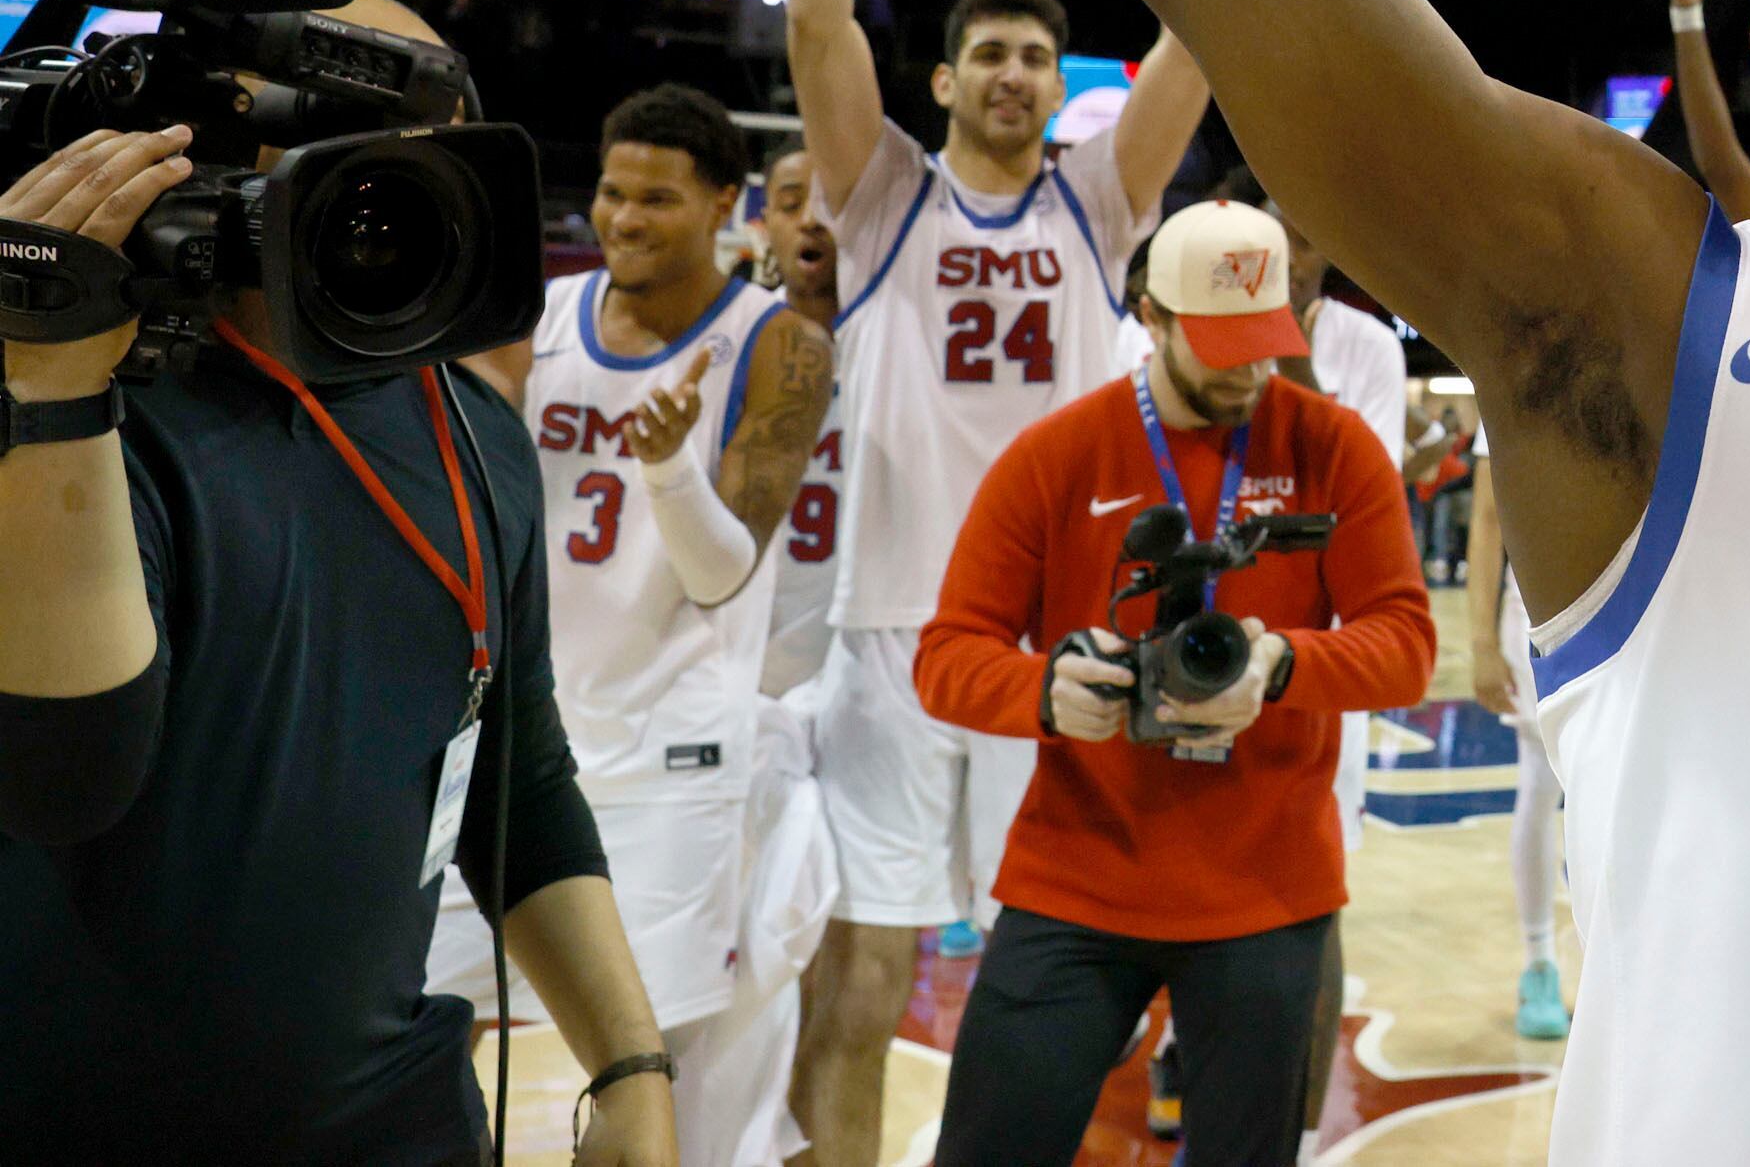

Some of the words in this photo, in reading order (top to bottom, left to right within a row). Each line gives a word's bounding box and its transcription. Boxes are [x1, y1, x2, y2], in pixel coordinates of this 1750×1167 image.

[306, 14, 350, 34] SONY
[0, 241, 57, 262] INON
[938, 246, 1063, 289] SMU
[944, 300, 1055, 383] 24
[539, 401, 640, 459] SM
[1236, 475, 1294, 498] SMU
[565, 470, 625, 565] 3
[786, 482, 838, 563] 9
